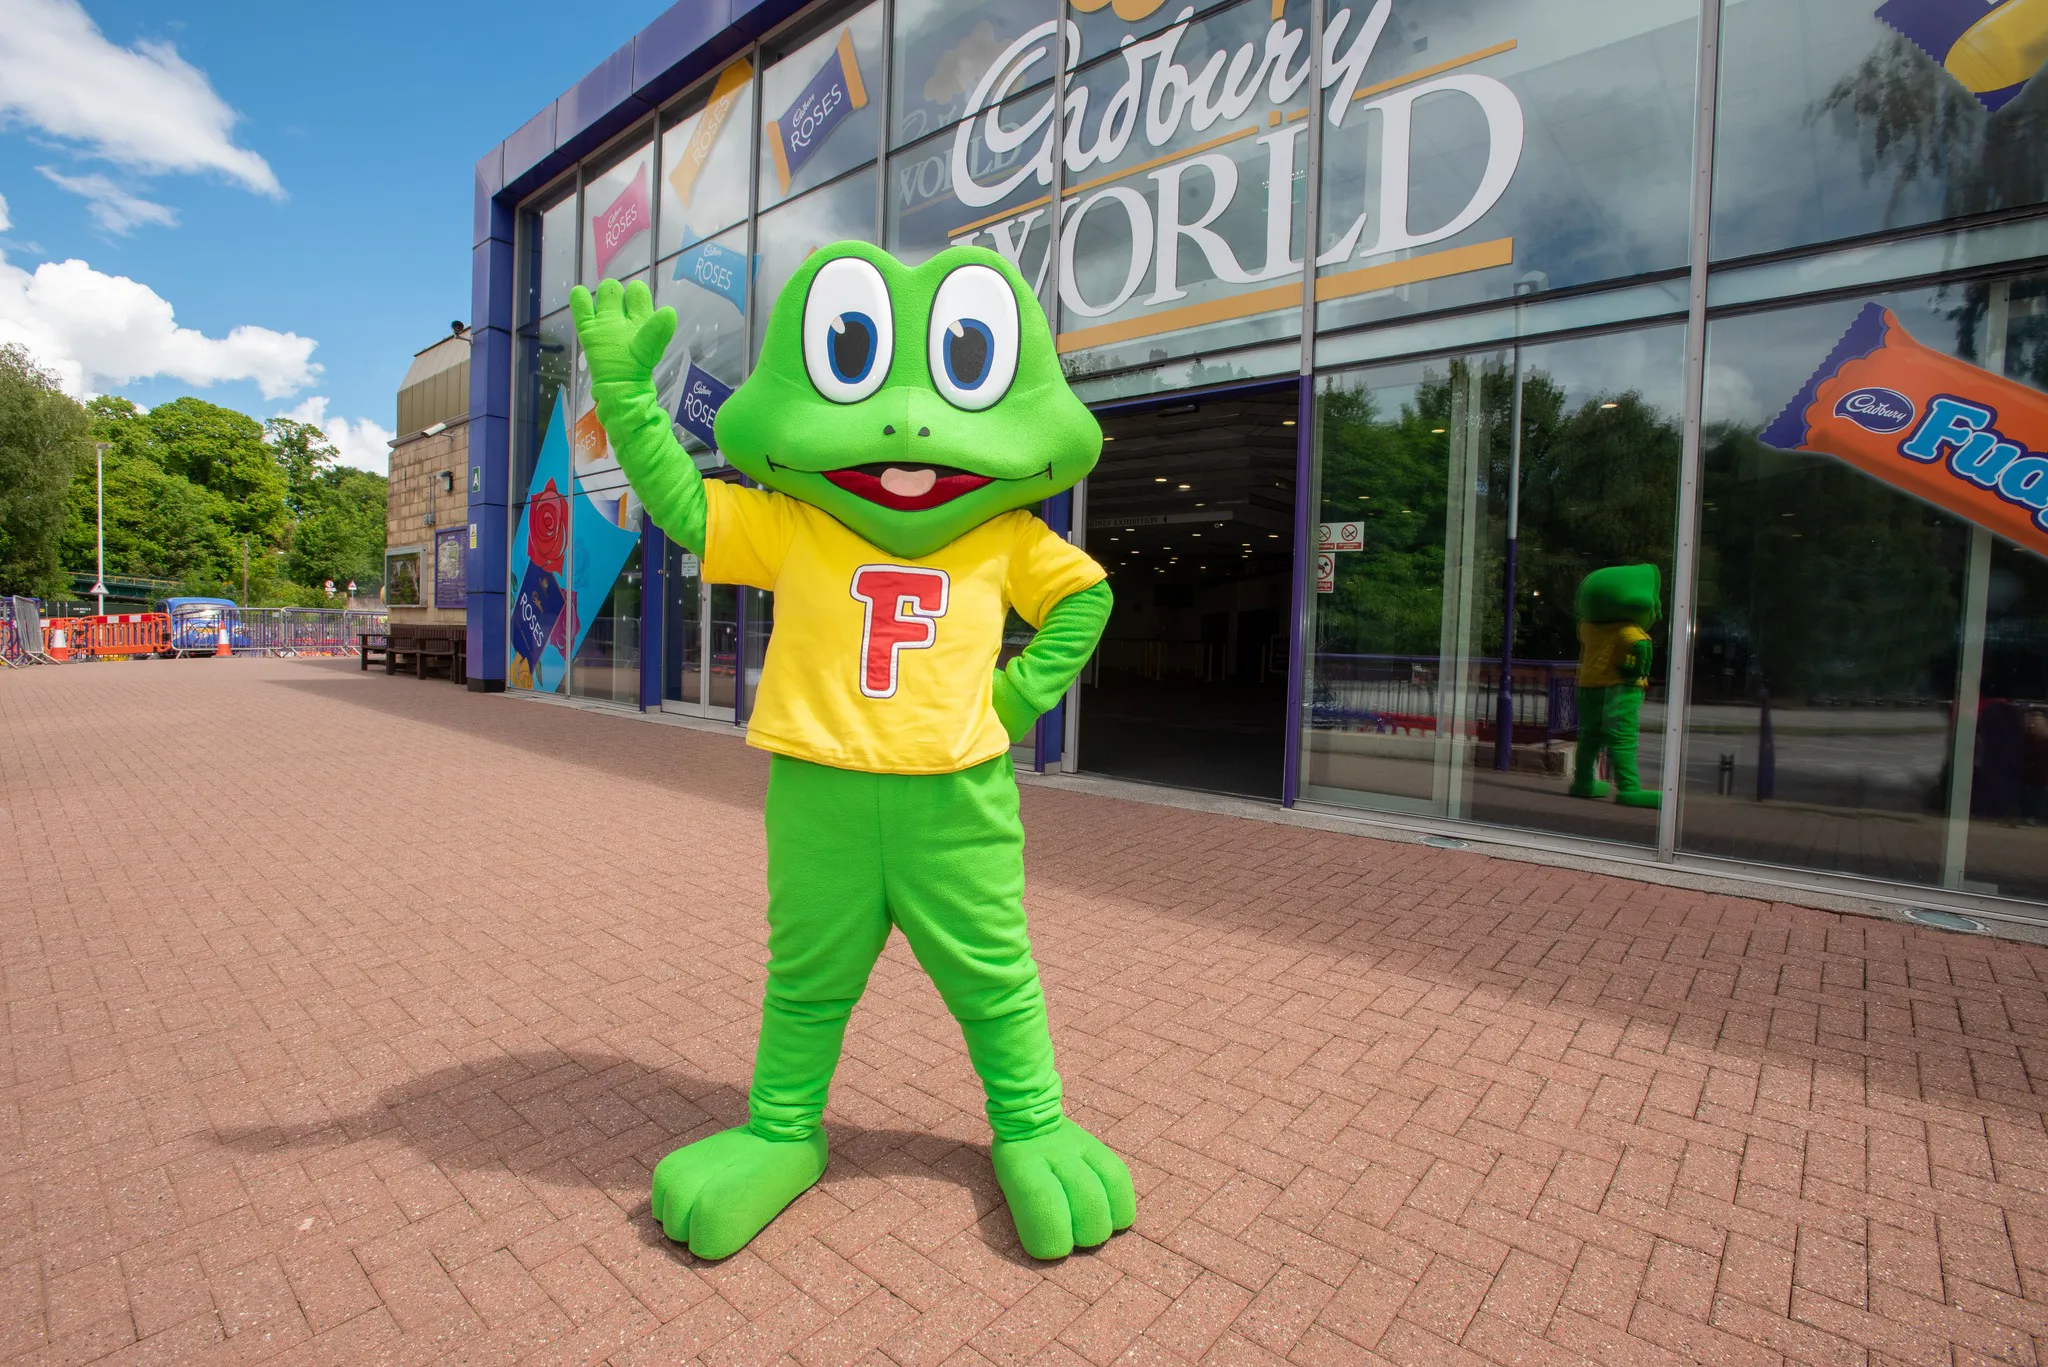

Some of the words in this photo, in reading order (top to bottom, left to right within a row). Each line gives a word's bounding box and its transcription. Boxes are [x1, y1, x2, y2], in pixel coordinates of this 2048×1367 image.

[693, 95, 730, 167] ROSES
[791, 83, 842, 153] ROSES
[951, 0, 1392, 207] Cadbury
[900, 122, 1023, 206] WOLD
[605, 204, 637, 249] ROSES
[695, 256, 733, 291] ROSES
[684, 392, 717, 429] ROSE
[1845, 394, 1907, 423] Cadbury
[1114, 517, 1158, 526] EXHIBITION
[520, 592, 544, 648] ROSES
[850, 564, 950, 698] F
